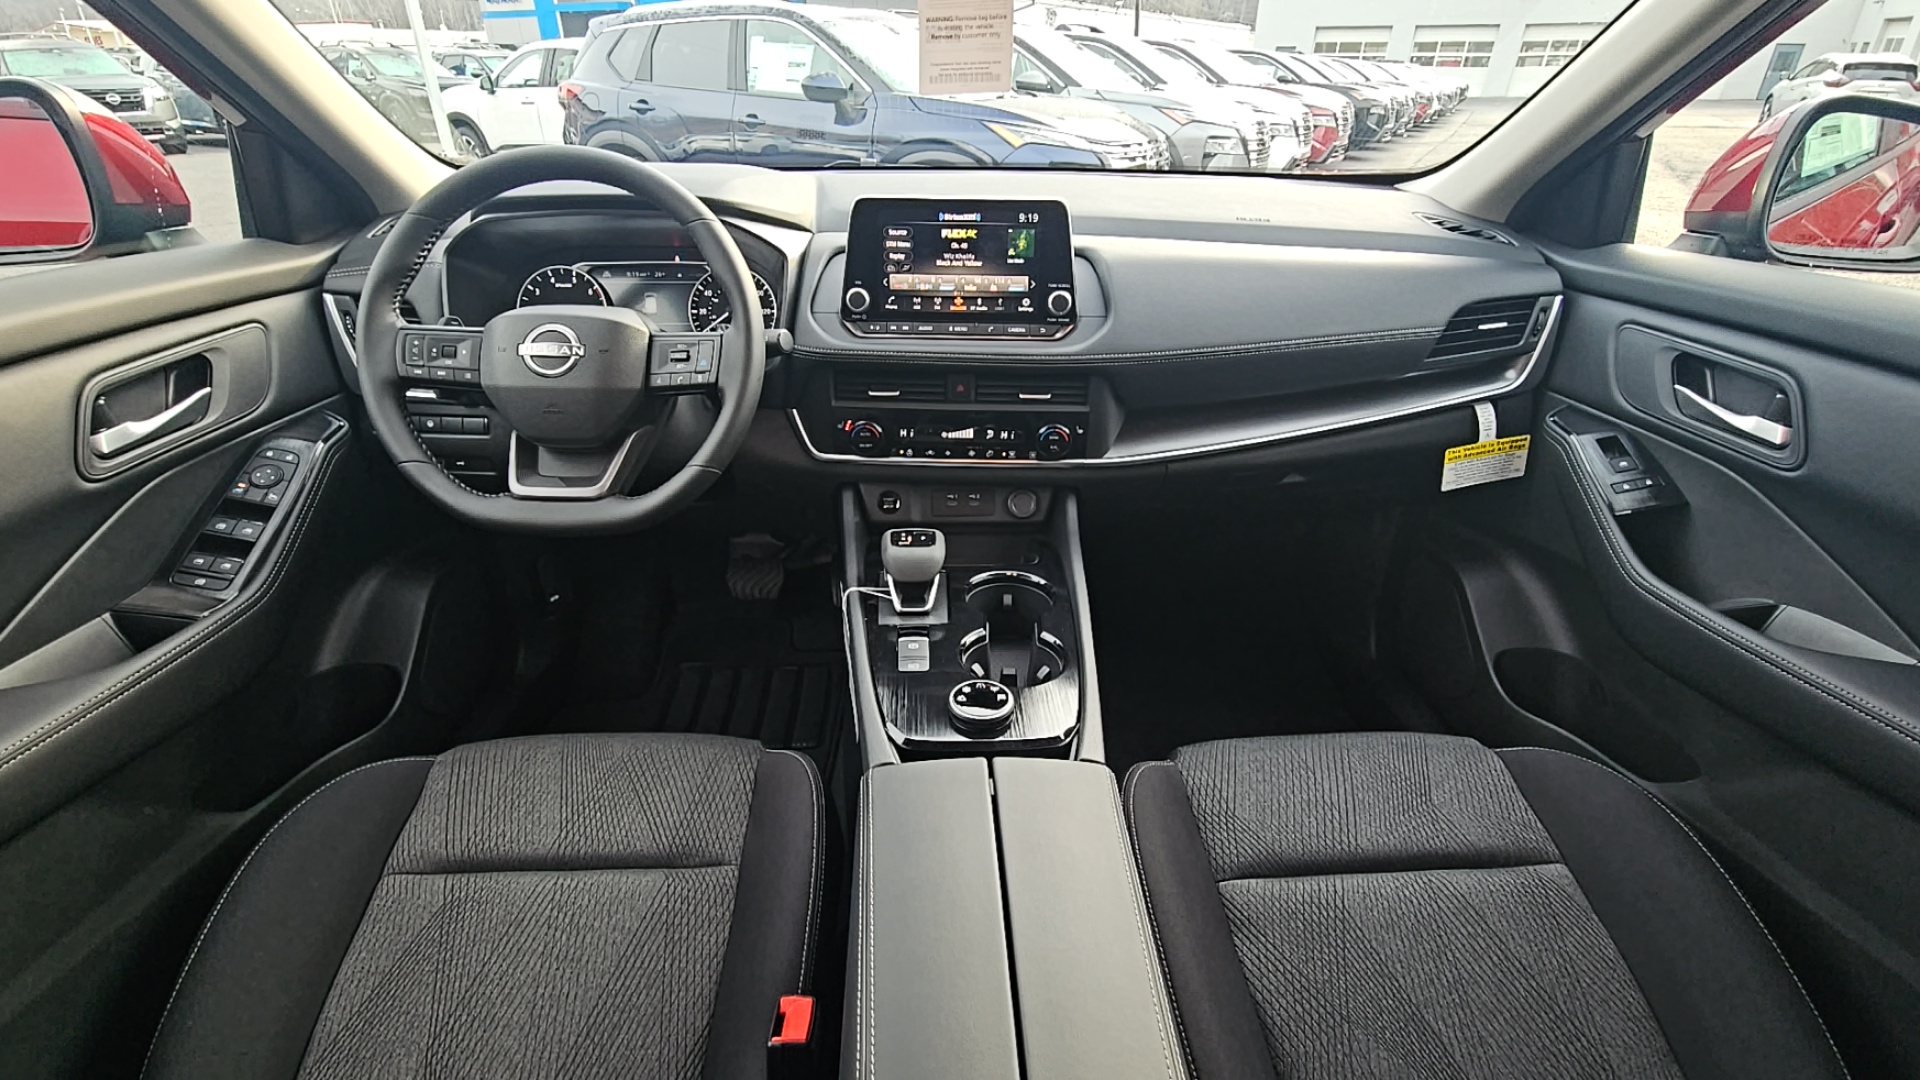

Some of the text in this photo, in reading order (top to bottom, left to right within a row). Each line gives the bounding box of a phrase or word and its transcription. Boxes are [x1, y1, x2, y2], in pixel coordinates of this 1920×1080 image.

[978, 14, 988, 22] tag
[1018, 212, 1039, 223] 9:19
[888, 228, 908, 236] Source
[704, 289, 713, 297] 40
[1464, 443, 1487, 452] Vehicle
[1497, 436, 1528, 447] Equipped
[1448, 454, 1462, 462] with
[1463, 449, 1496, 459] Advanced
[1509, 443, 1526, 451] Bags
